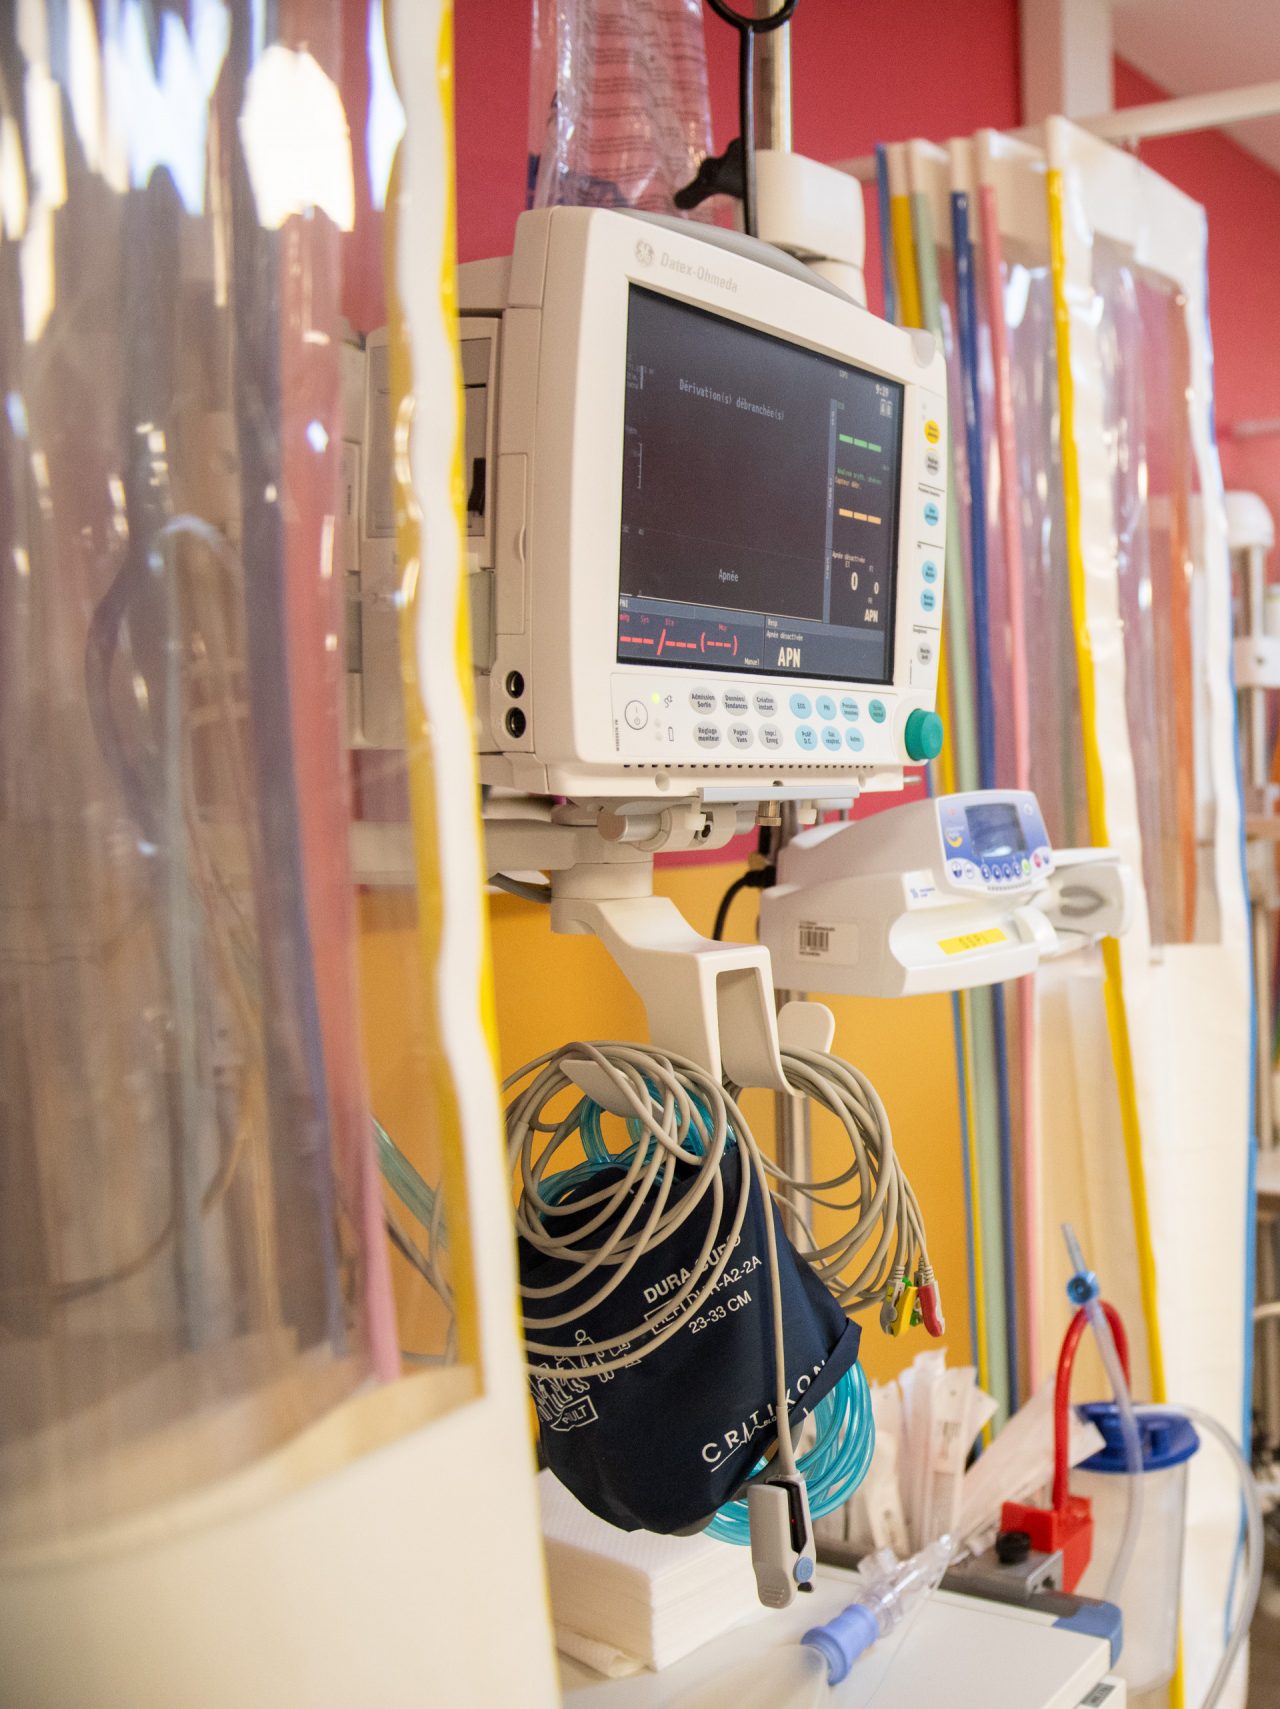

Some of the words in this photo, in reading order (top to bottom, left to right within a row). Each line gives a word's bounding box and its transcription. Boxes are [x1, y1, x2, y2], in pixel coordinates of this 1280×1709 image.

[660, 252, 739, 293] Datex-Ohmeda
[679, 378, 732, 405] Dérivation(s)
[735, 395, 785, 421] débranchée(s)
[719, 568, 739, 583] Apnée
[864, 608, 879, 623] APN
[777, 646, 801, 669] APN
[688, 1305, 726, 1334] 23-33
[727, 1290, 752, 1311] CM
